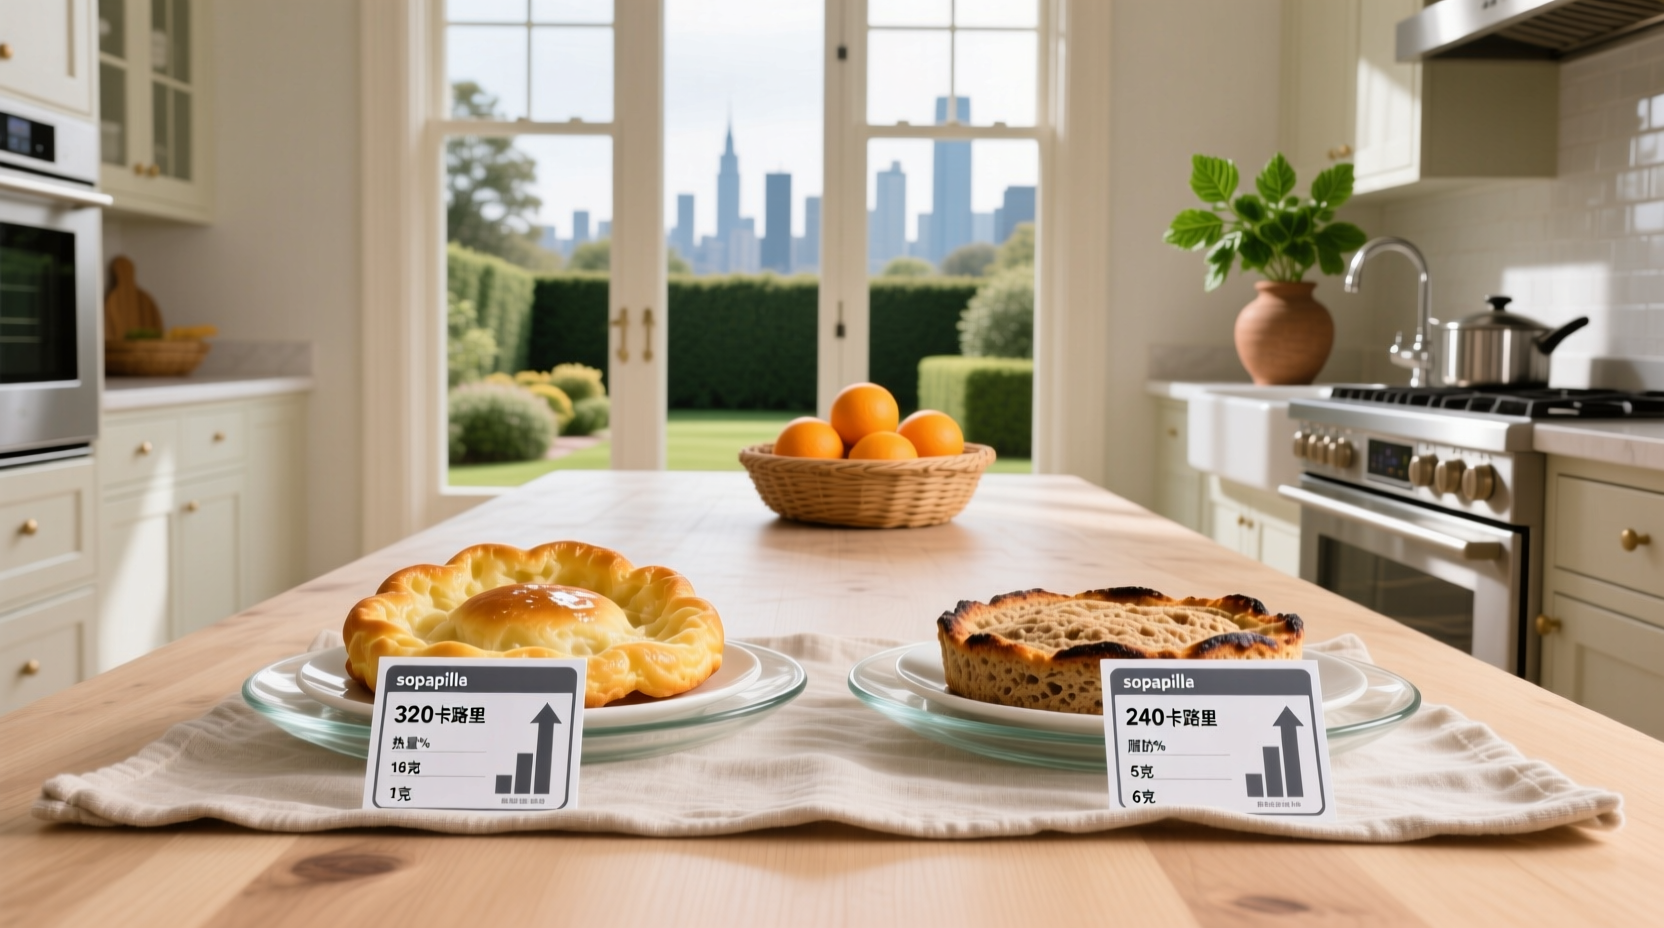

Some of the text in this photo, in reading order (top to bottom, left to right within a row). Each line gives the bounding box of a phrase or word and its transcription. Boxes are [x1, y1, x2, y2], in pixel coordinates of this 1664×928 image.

[396, 672, 468, 690] sopapilla
[1123, 673, 1195, 692] sopapilla
[394, 705, 486, 724] 320卡路里
[1125, 708, 1218, 727] 240卡路里
[1130, 764, 1155, 779] 5克
[389, 787, 412, 802] 1克
[1132, 789, 1156, 804] 6克
